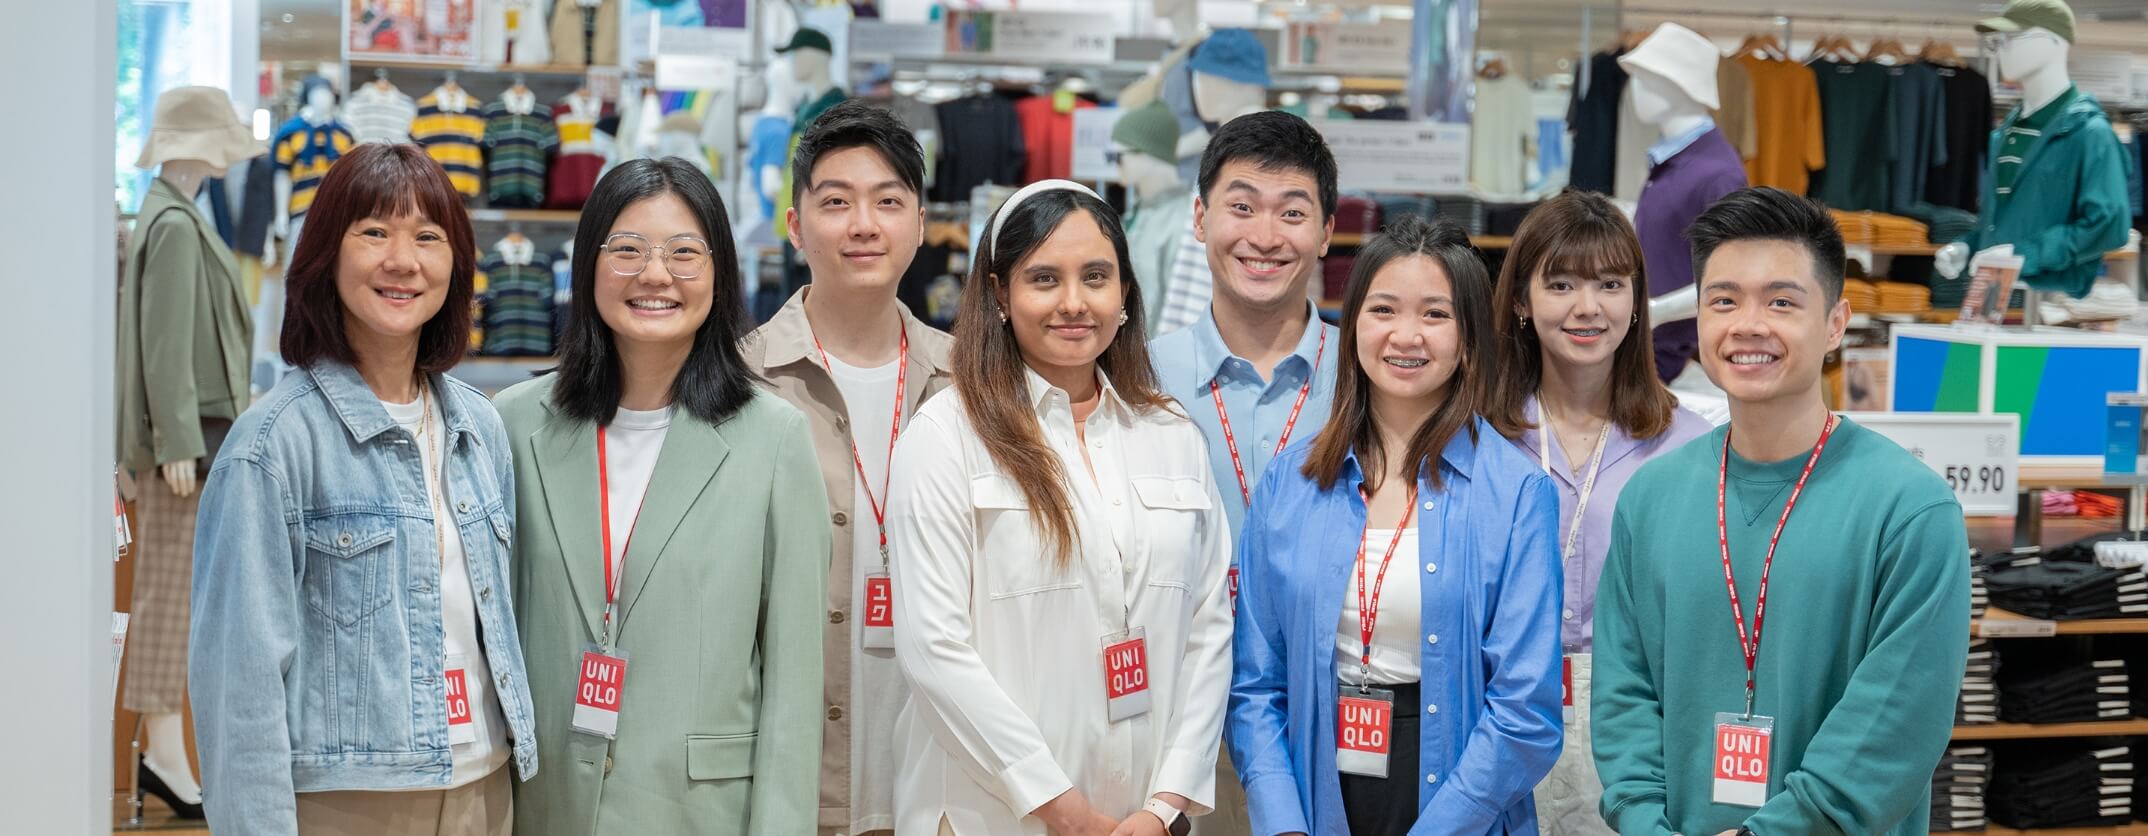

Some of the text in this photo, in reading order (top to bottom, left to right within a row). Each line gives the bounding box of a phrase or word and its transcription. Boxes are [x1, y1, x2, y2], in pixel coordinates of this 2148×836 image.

[1946, 466, 2004, 492] 59.90
[1111, 647, 1139, 670] UNI
[586, 660, 617, 684] UNI
[1113, 668, 1144, 694] QLO
[445, 676, 461, 696] NI
[582, 682, 616, 705] QLO
[447, 699, 466, 718] LO
[1345, 705, 1380, 726] UNI
[1343, 726, 1383, 748] QLO
[1724, 732, 1761, 755] UNI
[1722, 755, 1763, 777] QLO
